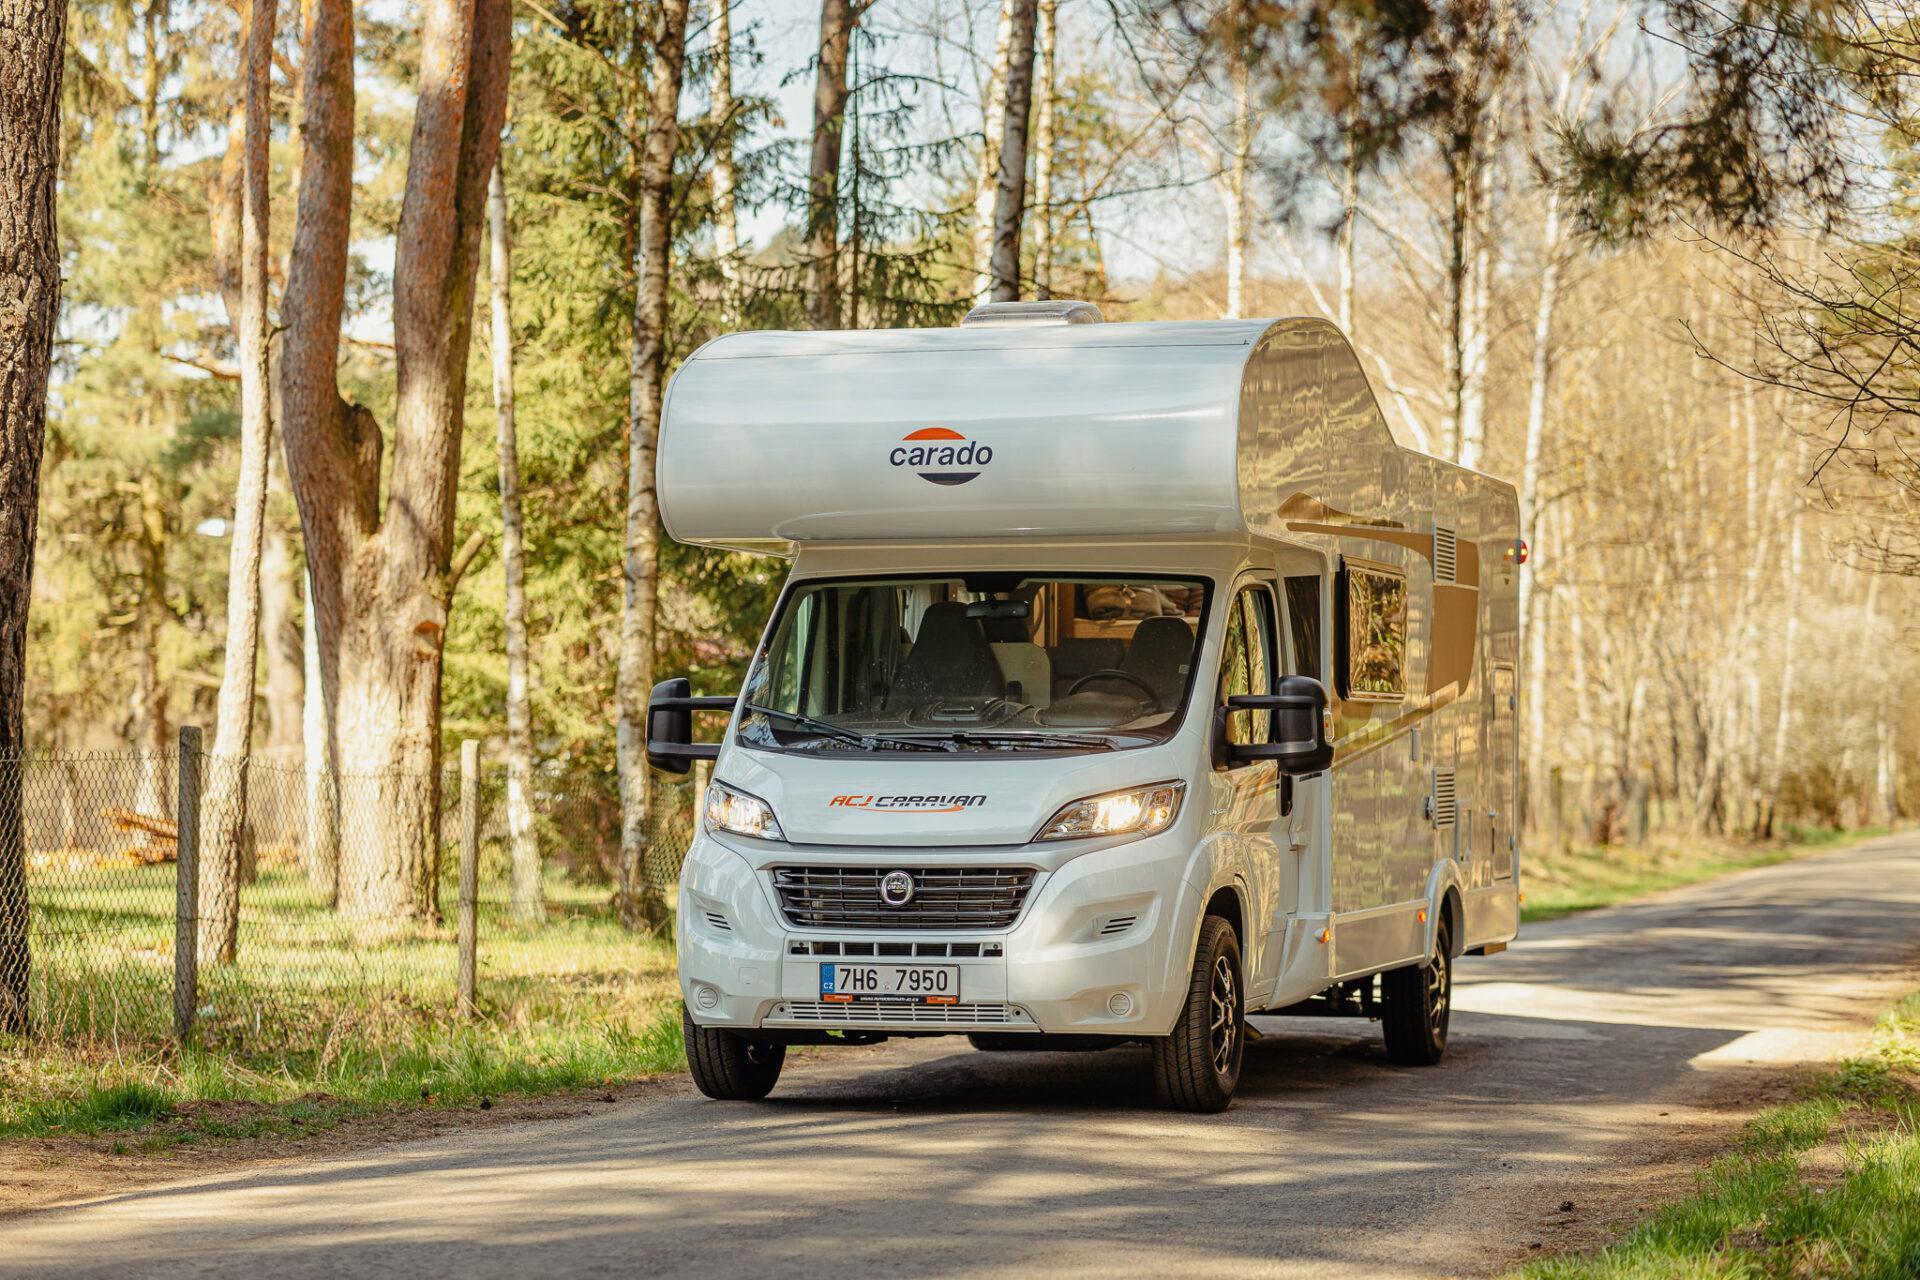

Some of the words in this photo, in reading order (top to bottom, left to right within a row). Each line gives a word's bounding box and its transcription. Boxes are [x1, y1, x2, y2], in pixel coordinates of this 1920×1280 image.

[890, 441, 993, 466] carado
[829, 795, 873, 807] ACJ
[875, 795, 987, 807] CARAVAN
[840, 968, 878, 990] 7H6
[896, 969, 948, 991] 7950
